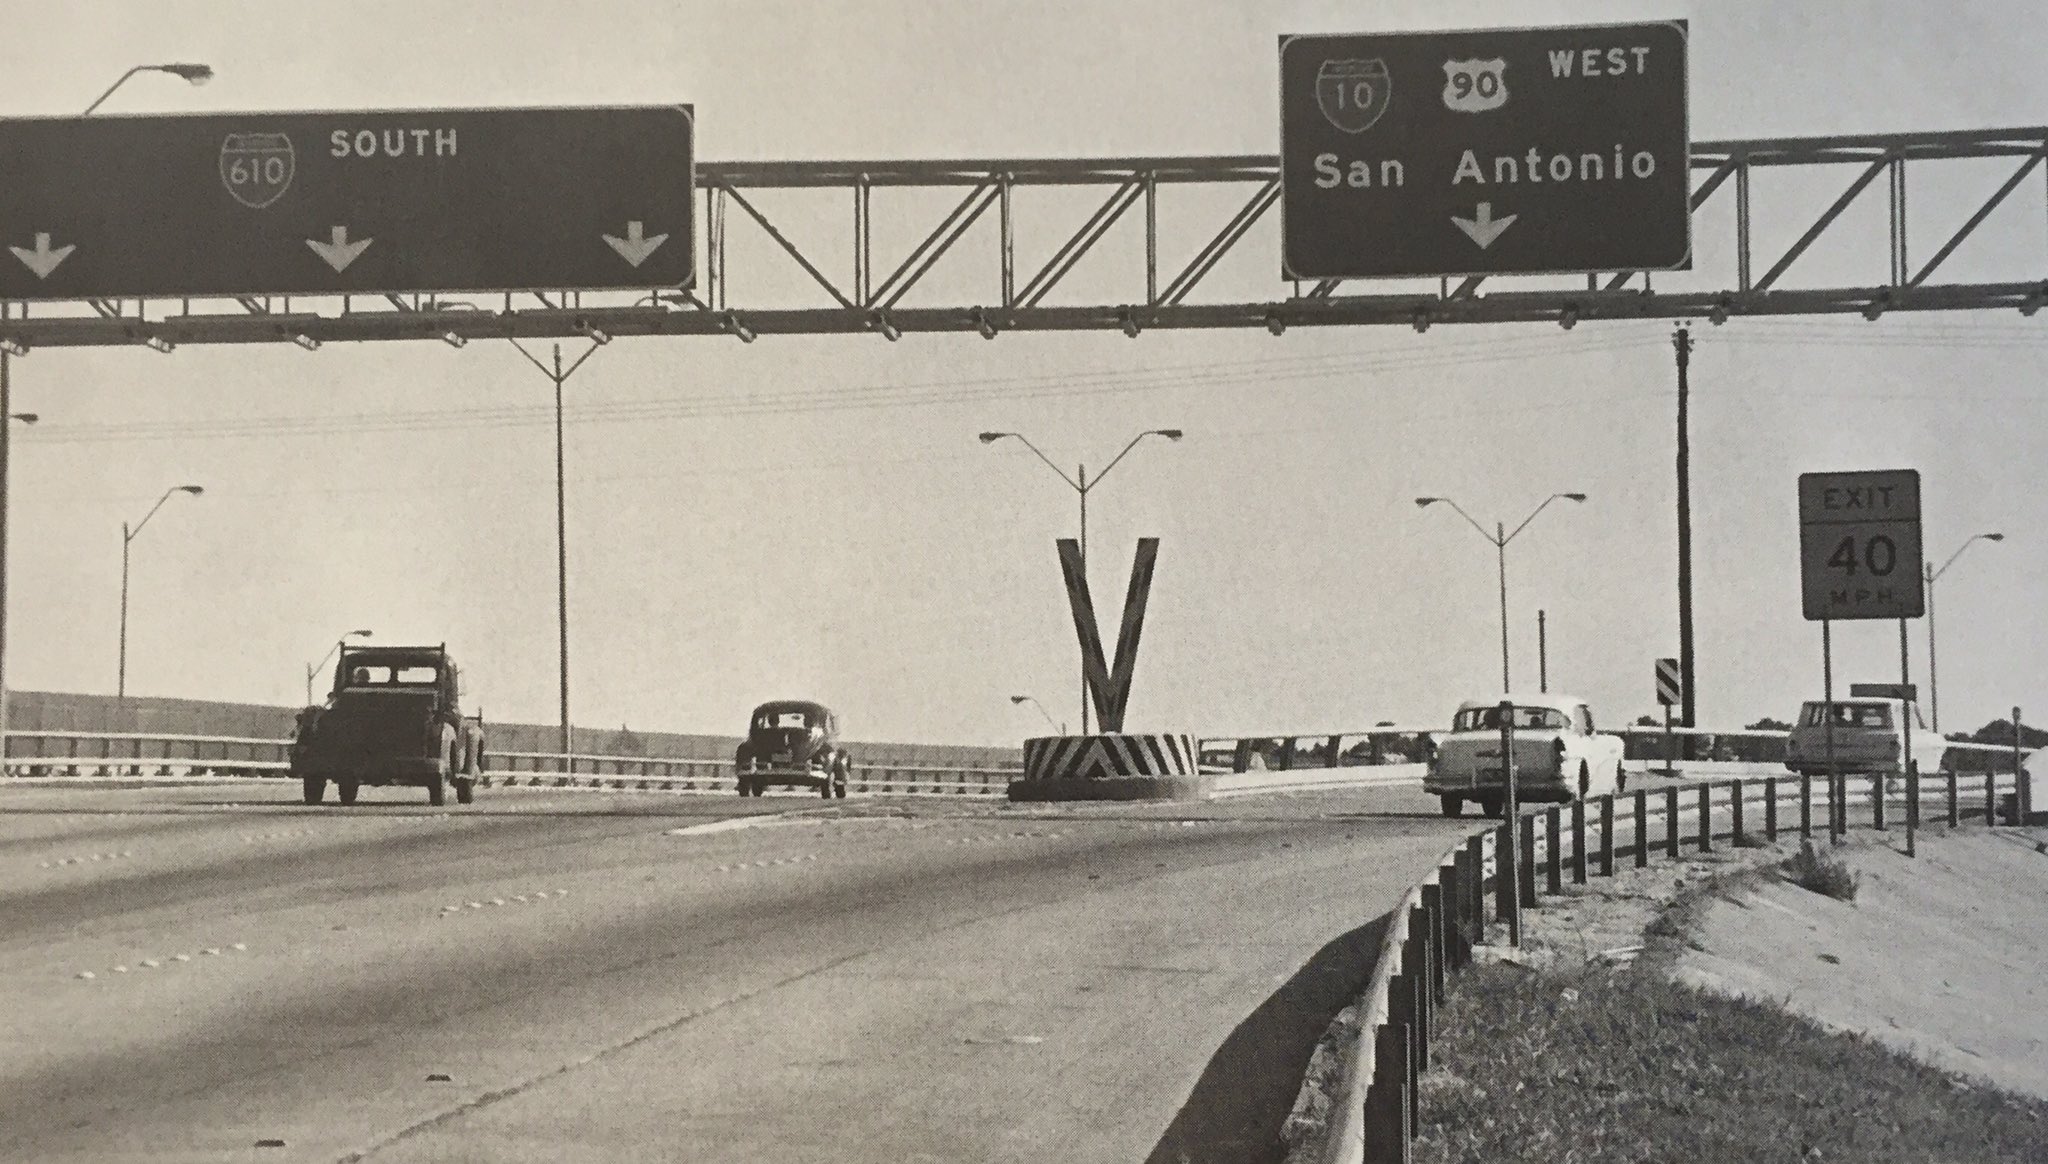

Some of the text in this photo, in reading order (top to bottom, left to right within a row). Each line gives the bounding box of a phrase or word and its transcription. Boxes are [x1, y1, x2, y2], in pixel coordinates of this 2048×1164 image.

[1548, 46, 1650, 77] WEST
[1336, 83, 1373, 110] 10
[1453, 71, 1498, 99] 90
[329, 129, 458, 157] SOUTH
[230, 157, 284, 185] 610
[1314, 144, 1656, 188] San Antonio
[1823, 486, 1895, 509] EXIT
[1827, 535, 1896, 577] 40
[1829, 588, 1893, 604] MPH
